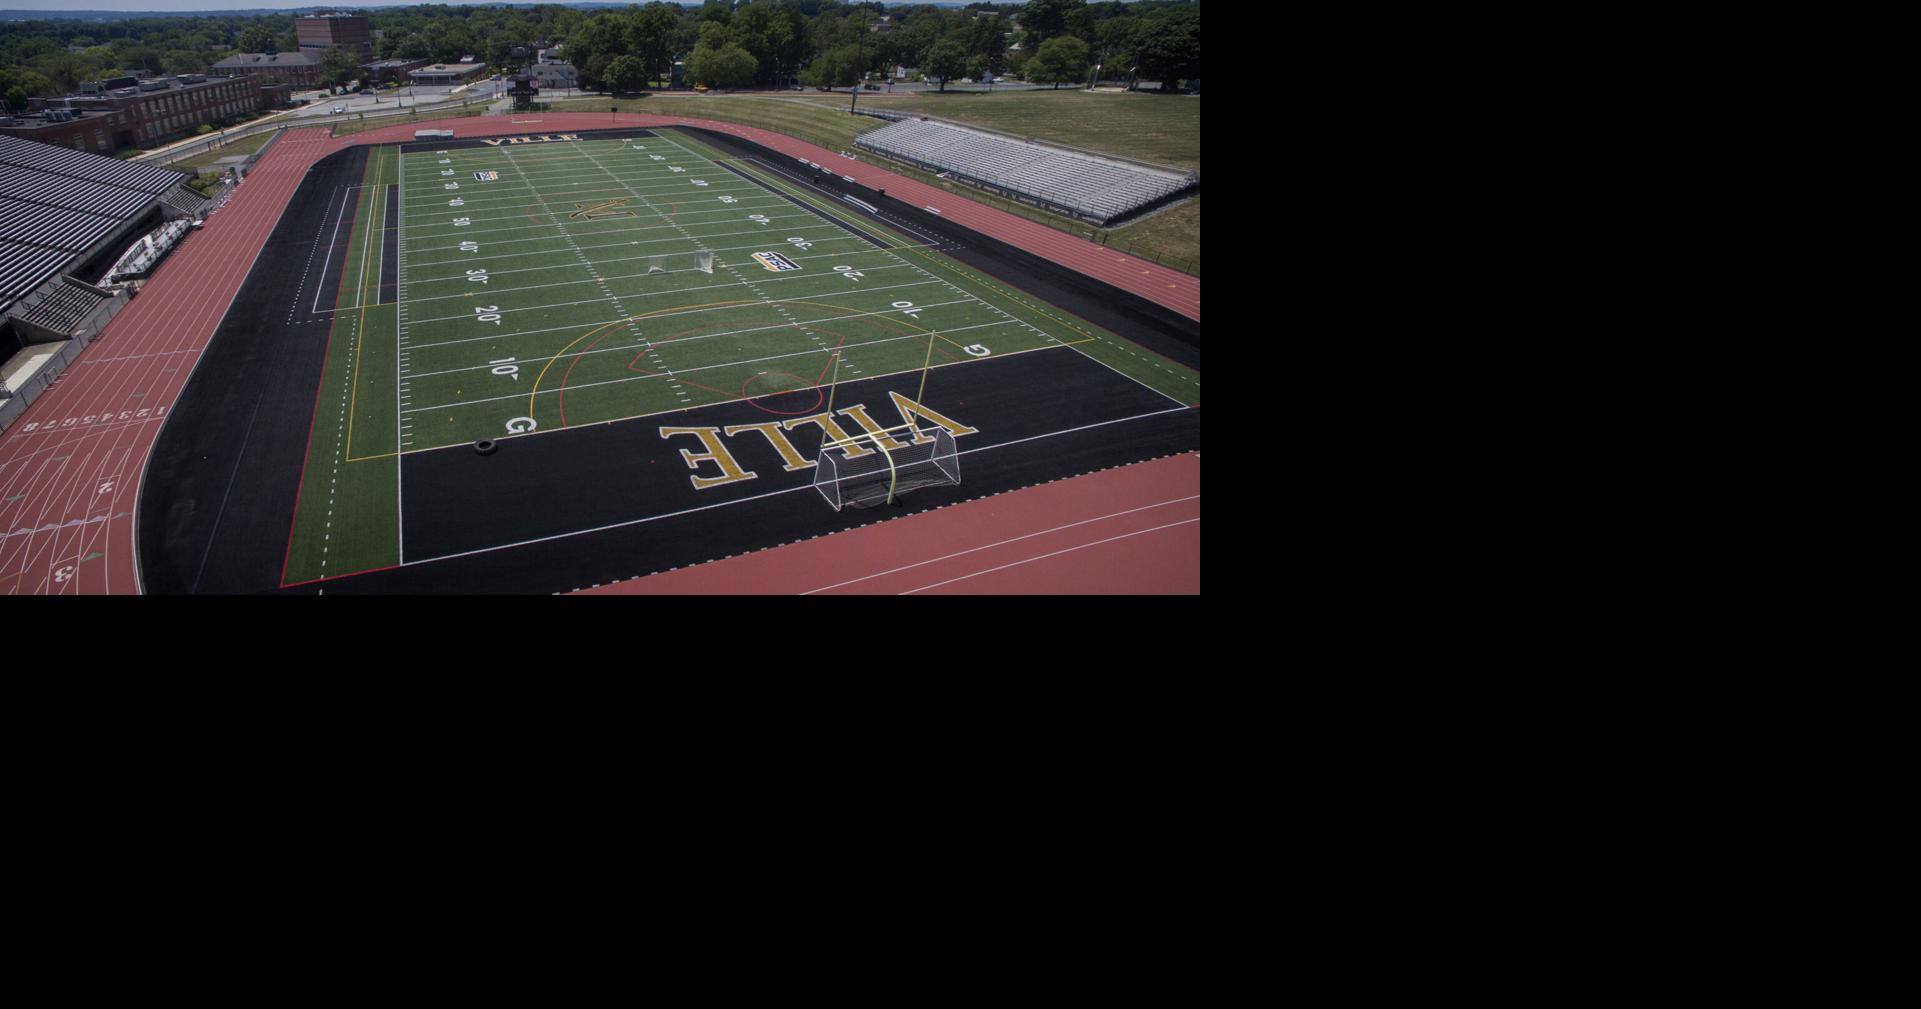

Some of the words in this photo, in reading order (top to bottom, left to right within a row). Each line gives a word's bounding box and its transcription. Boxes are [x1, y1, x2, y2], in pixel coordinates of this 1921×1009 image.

[480, 134, 584, 146] VILLE
[786, 237, 813, 249] 30
[466, 268, 489, 283] 30
[832, 265, 865, 279] 20
[475, 305, 502, 323] 20
[891, 300, 923, 315] 10
[963, 343, 992, 358] G
[489, 357, 519, 376] 10
[118, 410, 133, 420] 3
[136, 408, 150, 417] 2
[157, 406, 166, 415] 1
[42, 419, 57, 430] 7
[62, 417, 78, 427] 6
[81, 415, 96, 425] 5
[101, 413, 114, 423] 4
[23, 422, 39, 432] 8
[505, 416, 537, 435] G
[658, 390, 980, 490] VILLE
[98, 480, 115, 494] 2
[54, 565, 73, 583] 3
